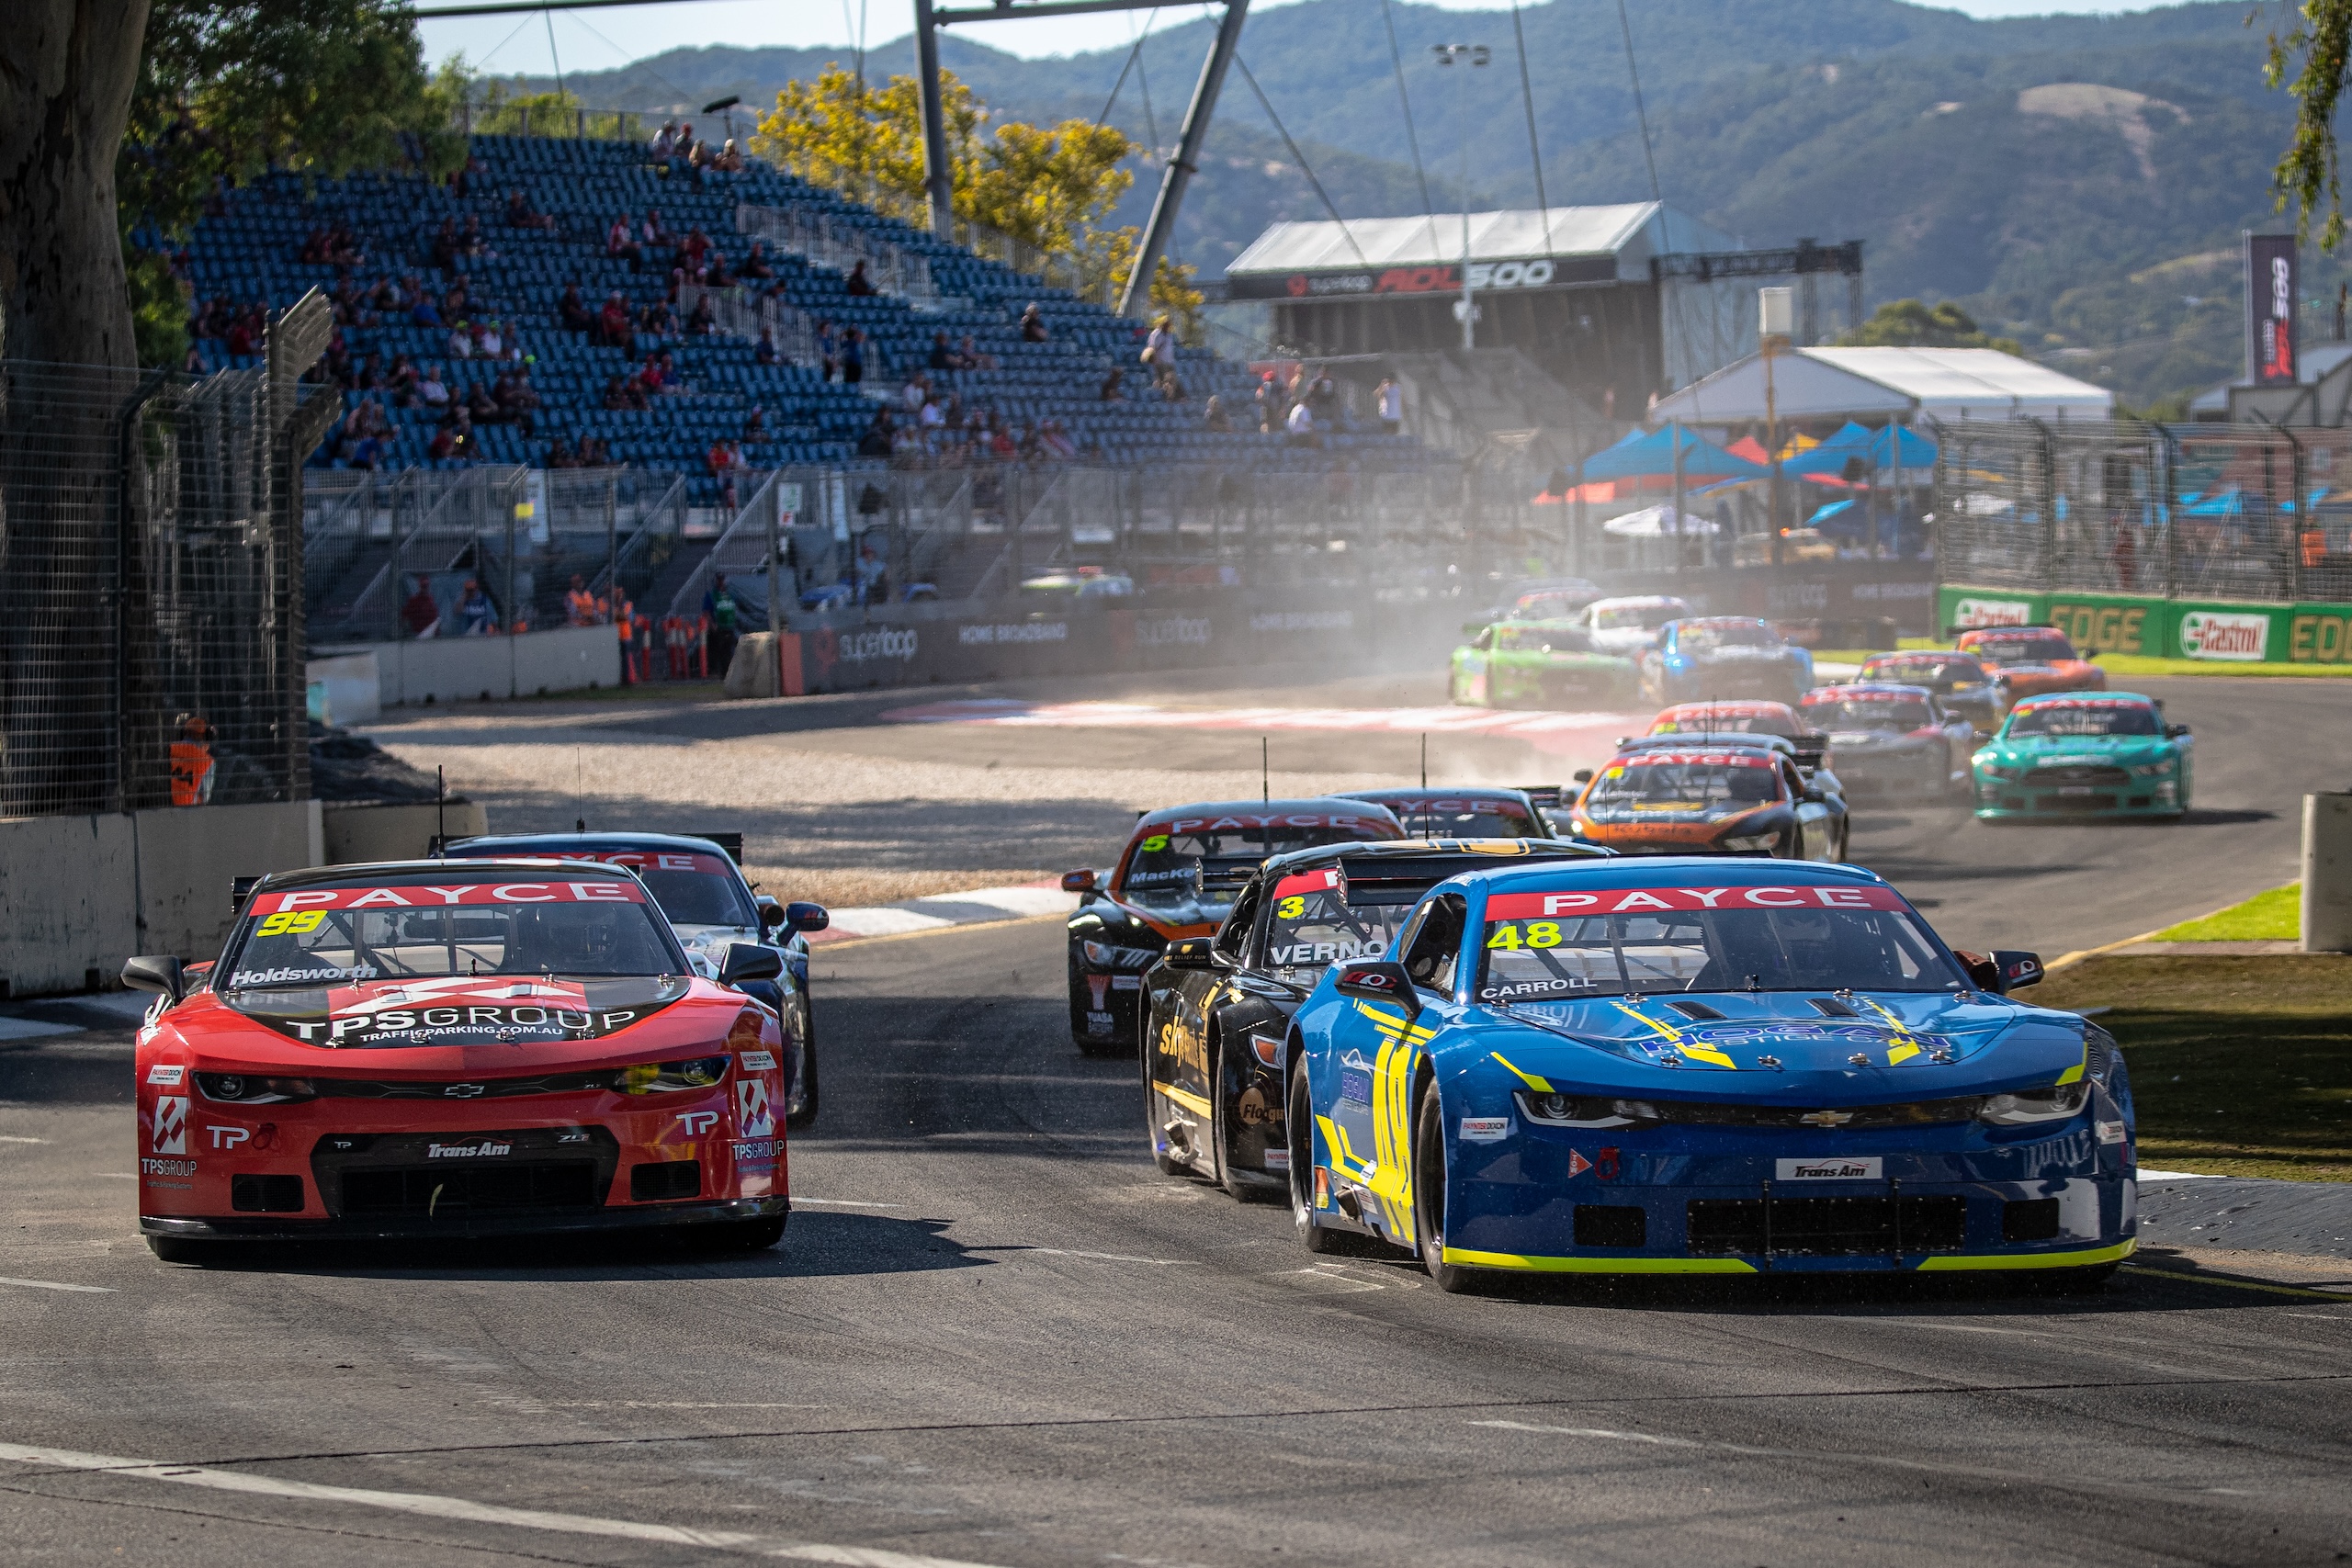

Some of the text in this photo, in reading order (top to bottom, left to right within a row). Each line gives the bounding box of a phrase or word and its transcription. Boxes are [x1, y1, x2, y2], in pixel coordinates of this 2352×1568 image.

[840, 625, 917, 663] superloop
[2200, 617, 2264, 653] Castrol
[1627, 754, 1752, 767] PAYCE
[1171, 815, 1360, 834] PAYCE
[1142, 834, 1170, 852] 5
[277, 883, 629, 913] PAYCE
[1277, 896, 1306, 919] 3
[1544, 887, 1872, 916] PAYCE
[256, 909, 328, 938] 99
[1487, 921, 1563, 951] 48
[230, 964, 378, 987] Holdsworth
[1480, 976, 1598, 999] CARROLL
[286, 1007, 636, 1040] TPSGROUP
[360, 1026, 563, 1043] TRAFFICPARKING.COM.AU
[1639, 1024, 1951, 1053] HOGAN
[675, 1111, 719, 1136] TP
[206, 1125, 250, 1149] TP
[334, 1141, 352, 1149] TP
[428, 1142, 511, 1158] Trans Am
[732, 1140, 785, 1160] TPSGROUP
[141, 1158, 197, 1176] TPSGROUP
[1570, 1154, 1579, 1174] TOW
[1794, 1165, 1866, 1178] Trans Am
